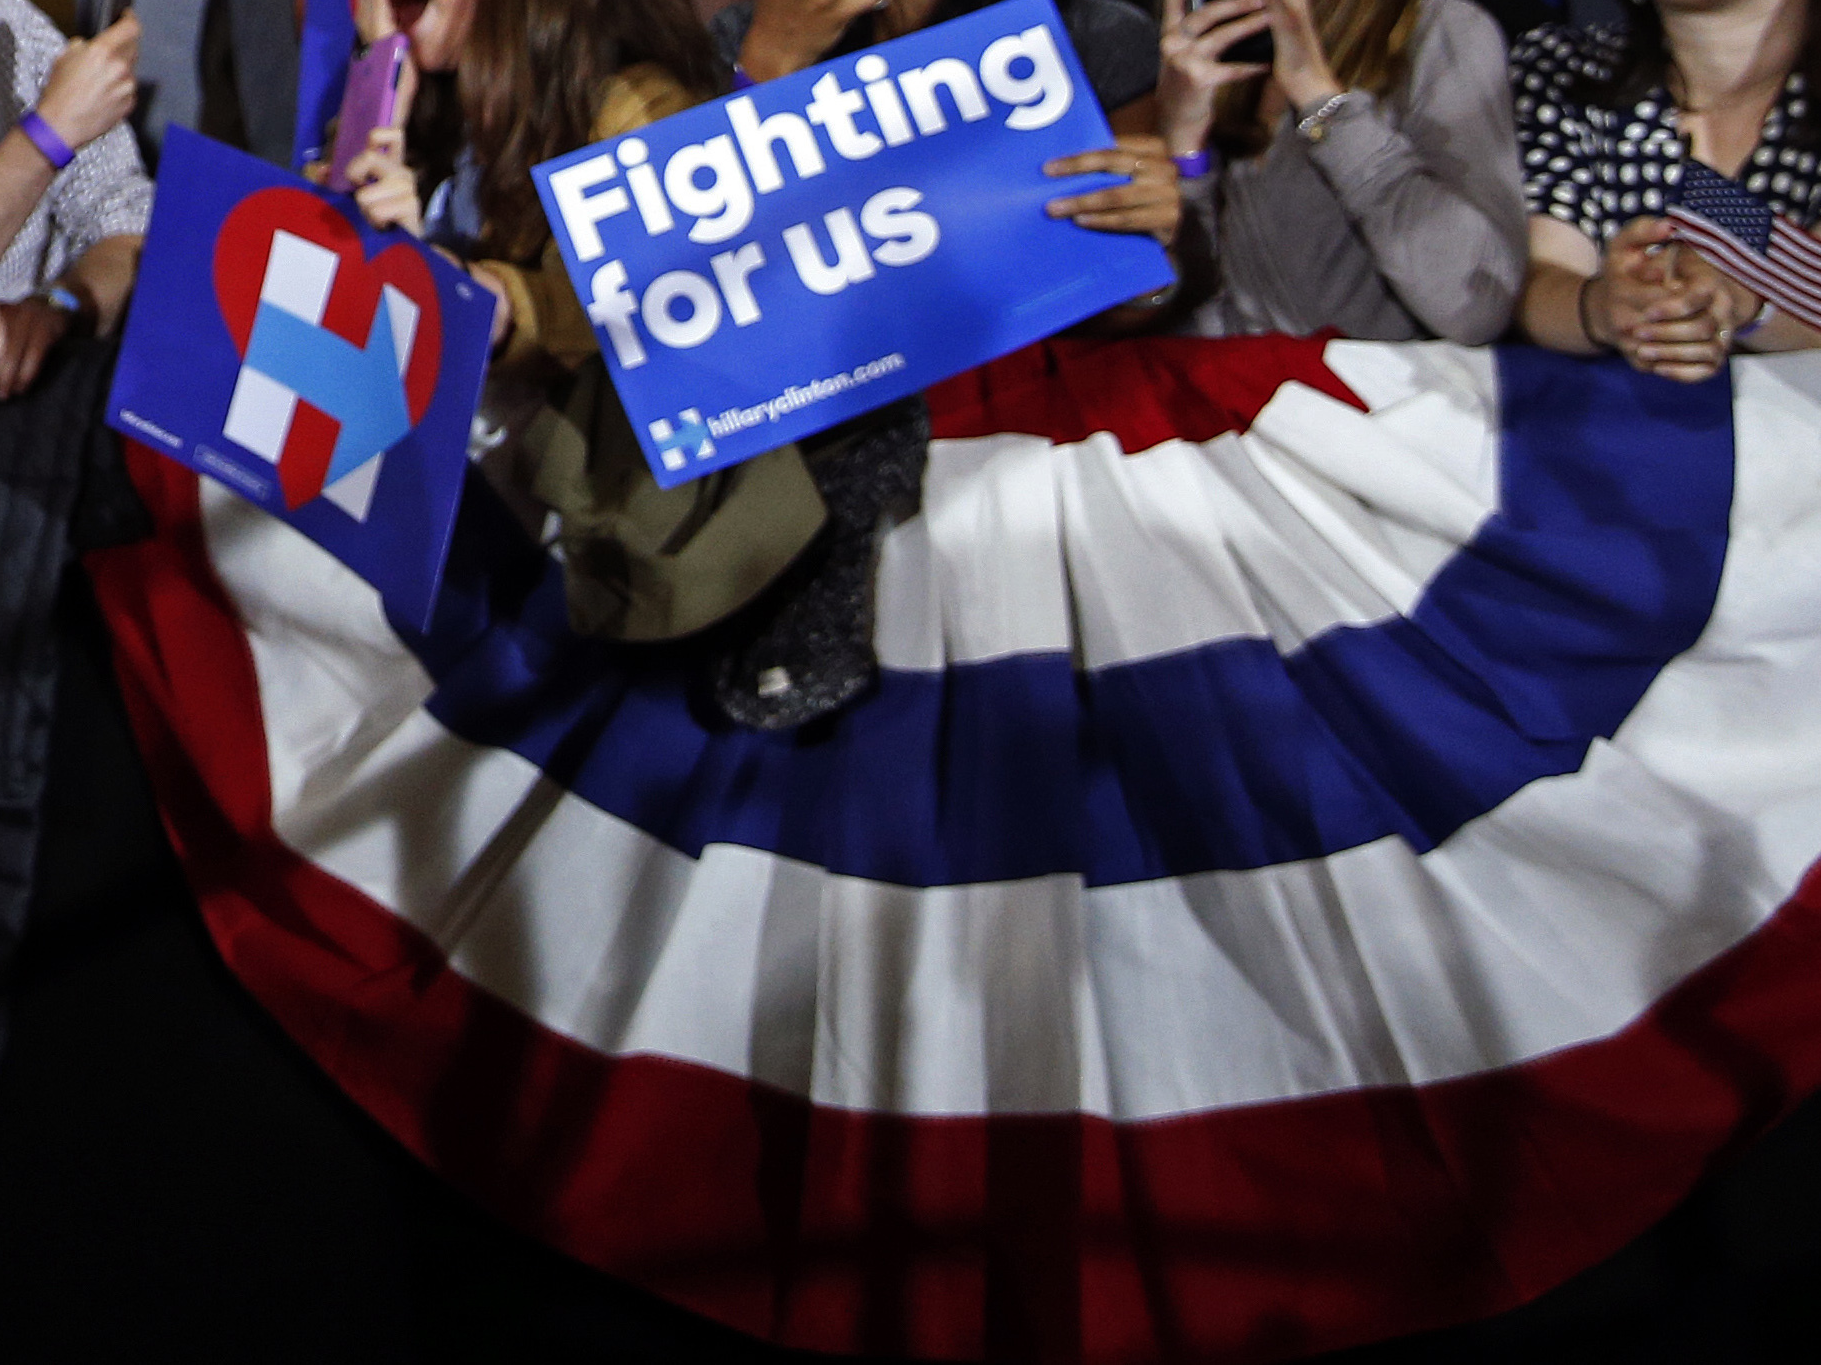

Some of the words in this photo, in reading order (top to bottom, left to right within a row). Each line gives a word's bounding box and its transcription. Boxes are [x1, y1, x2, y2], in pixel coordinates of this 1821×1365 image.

[548, 24, 1074, 261] Fighting
[587, 241, 766, 369] for
[781, 186, 941, 295] us
[706, 352, 907, 439] hillaryclinton.com
